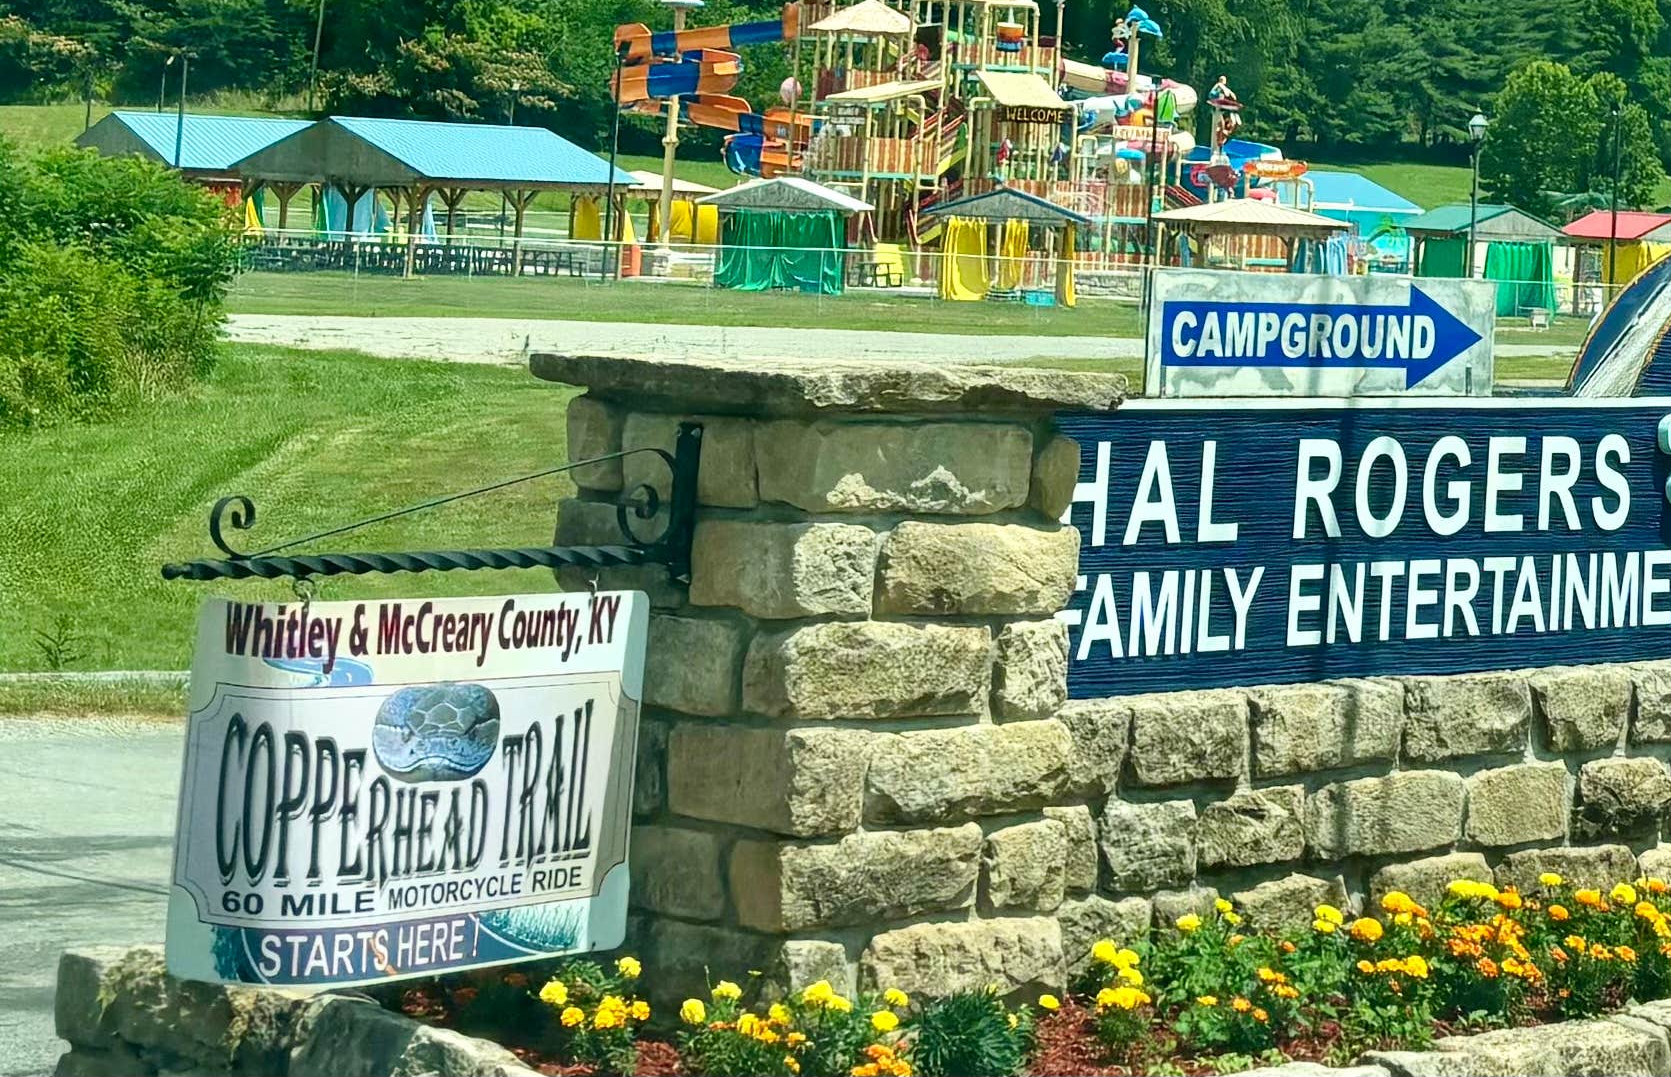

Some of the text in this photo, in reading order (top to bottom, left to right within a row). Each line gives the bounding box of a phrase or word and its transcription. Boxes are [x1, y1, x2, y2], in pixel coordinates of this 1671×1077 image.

[1005, 105, 1065, 124] WELCOME
[1171, 310, 1437, 361] CAMPGROUND
[1058, 432, 1632, 547] HAL ROGERS
[225, 595, 622, 674] Whitley & McCreary County, KY
[215, 699, 595, 890] COPPERHEAD TRAIL
[221, 866, 582, 917] 60 MILE MOTORCYCLE RIDE
[259, 930, 390, 978] STARTS
